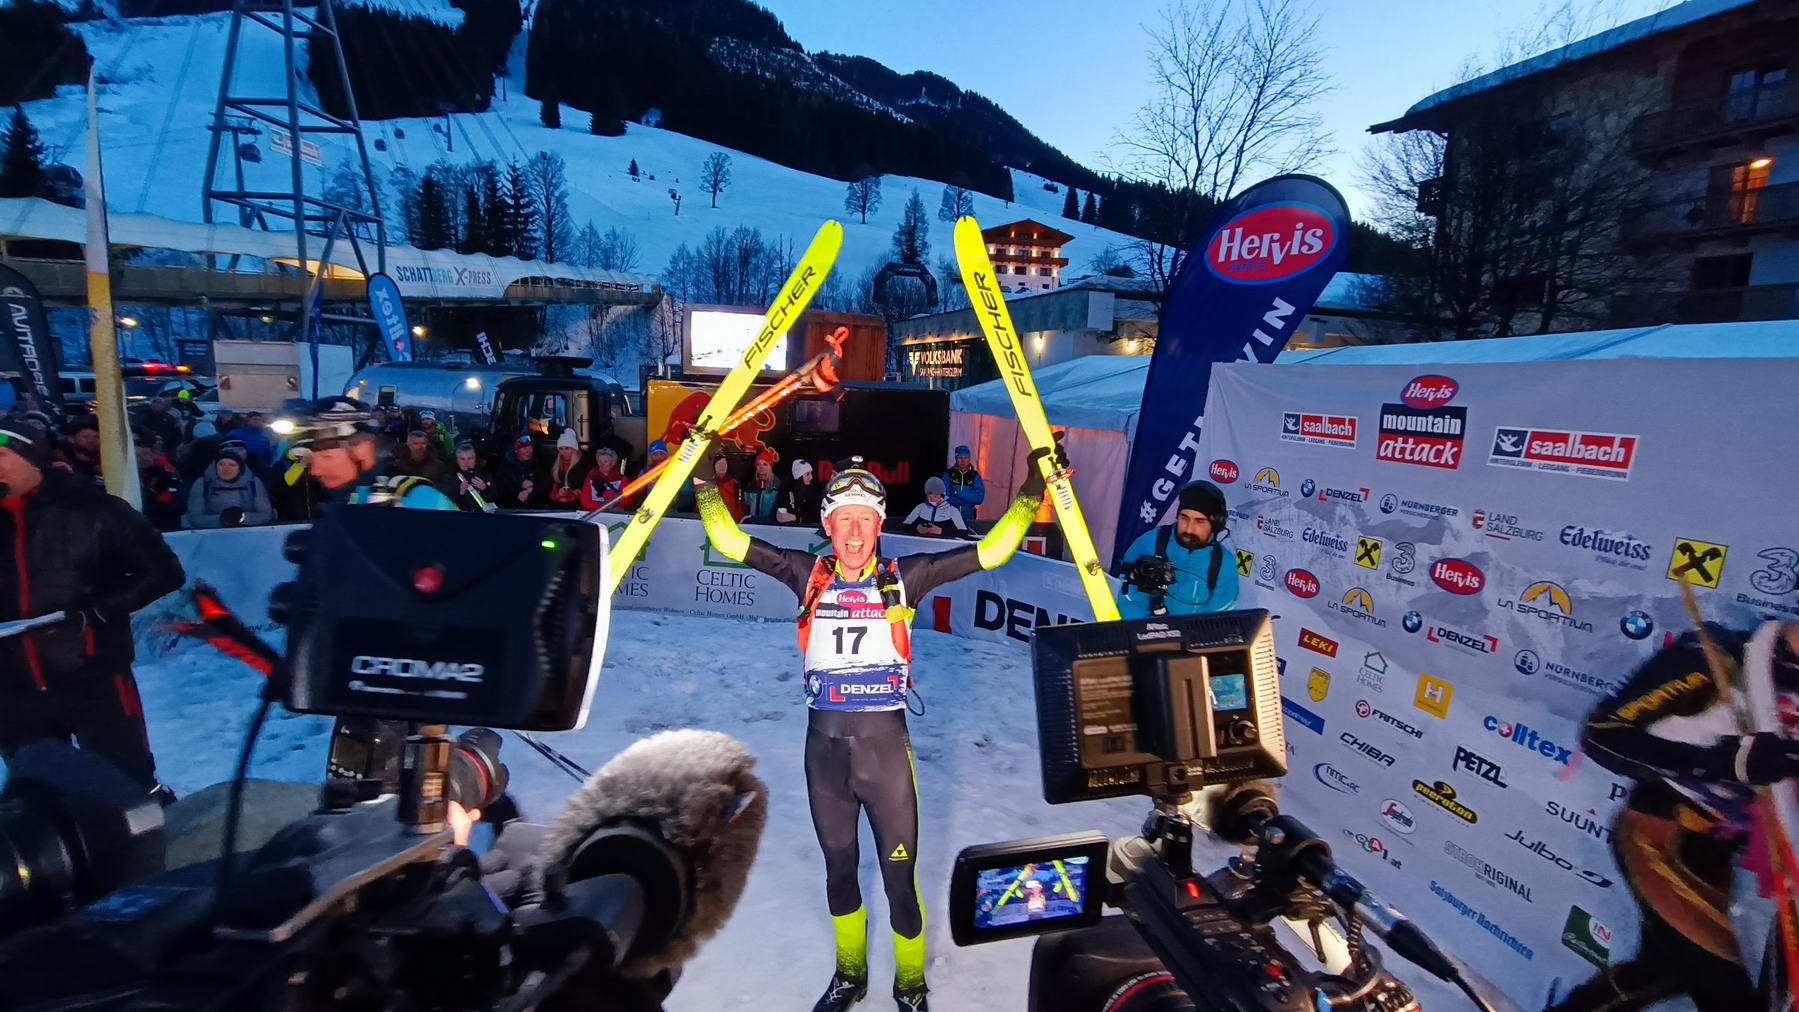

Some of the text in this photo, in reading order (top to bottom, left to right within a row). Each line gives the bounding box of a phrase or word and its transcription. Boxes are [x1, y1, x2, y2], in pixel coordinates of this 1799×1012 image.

[1218, 222, 1323, 264] Hervis
[453, 266, 492, 286] X-PRESS
[744, 265, 816, 369] FISCHER
[974, 272, 1032, 397] FISCHER
[920, 349, 963, 365] VOLKSBANK
[1405, 383, 1454, 401] Hervis
[1304, 416, 1352, 436] saalbach
[1383, 413, 1461, 435] mountain
[1379, 437, 1459, 466] attack
[1530, 433, 1627, 463] saalbach
[1211, 463, 1237, 479] Hervis
[1253, 484, 1289, 497] SPORTIVA
[1326, 488, 1363, 502] DENZEL
[1400, 499, 1458, 517] NÜRNBERGER
[1489, 512, 1518, 525] LAND
[1264, 517, 1280, 526] LAND
[1264, 524, 1293, 538] SALZBURG
[1486, 522, 1543, 541] SALZBURG
[1302, 527, 1348, 552] Edelweiss
[1560, 525, 1651, 560] Edelweiss
[696, 569, 756, 589] CELTIC
[1288, 572, 1316, 593] Hervis
[1435, 563, 1480, 589] Hervis
[614, 582, 649, 597] MES
[695, 586, 755, 607] HOMES
[838, 594, 865, 604] Hervis
[815, 607, 886, 618] mountain attac
[1340, 605, 1387, 628] SPORTIVA
[1517, 604, 1593, 633] SPORTIVA
[832, 626, 868, 655] 17
[1303, 633, 1334, 653] LEKI
[1437, 627, 1489, 654] DENZEL
[840, 683, 894, 694] DENZEL
[1372, 709, 1423, 738] FRITSCHI
[1340, 732, 1395, 767] CHIBA
[1453, 746, 1508, 789] PETZL
[1416, 783, 1473, 820] peeroton
[1546, 801, 1613, 844] SUUNT
[1504, 830, 1573, 870] Julbo
